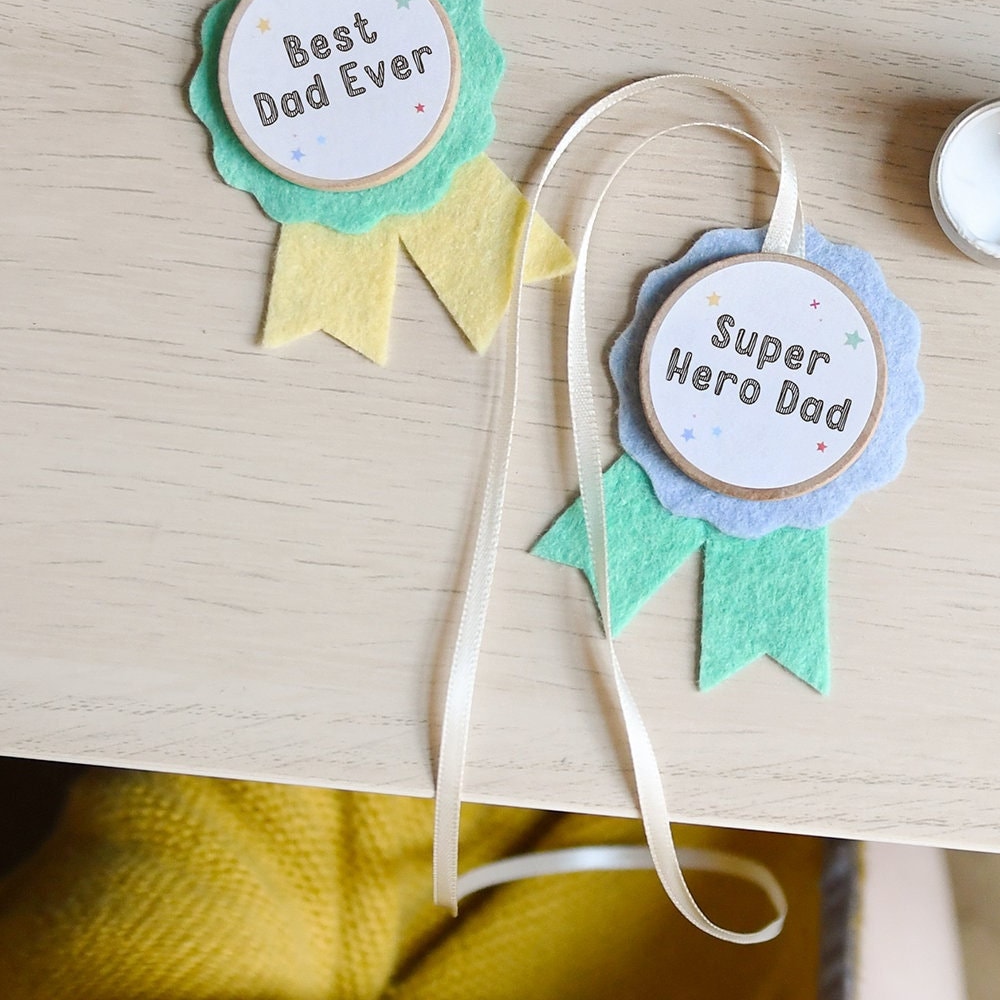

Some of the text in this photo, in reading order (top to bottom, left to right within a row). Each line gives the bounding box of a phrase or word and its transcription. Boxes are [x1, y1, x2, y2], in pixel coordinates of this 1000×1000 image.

[282, 11, 378, 68] Best
[252, 45, 433, 127] Dad Ever
[710, 313, 831, 375] Super
[665, 346, 853, 432] Hero Dad
